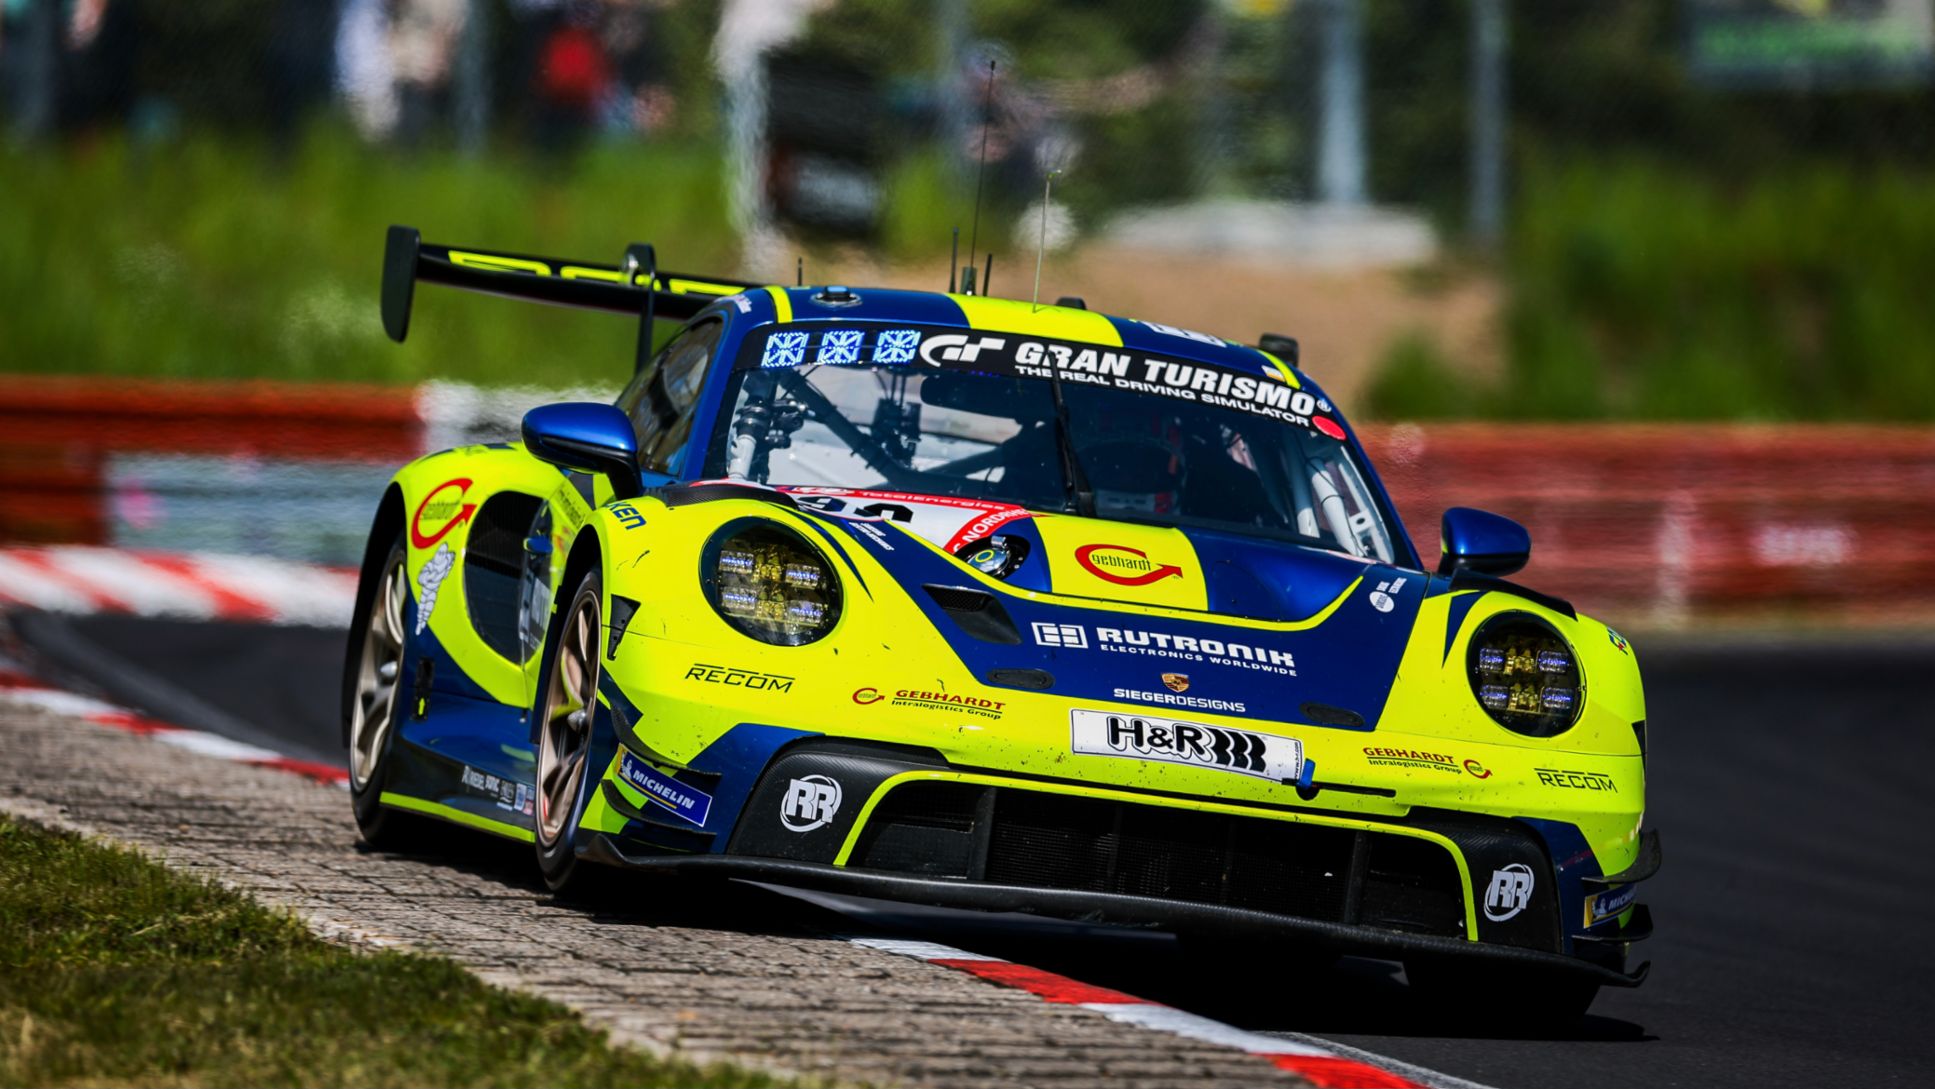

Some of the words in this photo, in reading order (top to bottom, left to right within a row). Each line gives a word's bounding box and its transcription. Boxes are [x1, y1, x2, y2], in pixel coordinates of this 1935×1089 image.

[1014, 342, 1130, 376] GRAN
[1014, 365, 1053, 377] THE
[1060, 371, 1110, 386] REAL
[1115, 378, 1196, 399] DRIVING
[1201, 393, 1309, 427] SIMULATOR
[1096, 626, 1295, 667] RUTRONIK
[1100, 644, 1203, 661] ELECTRONICS
[1209, 657, 1297, 677] WORLDWIDE
[684, 667, 793, 693] RECOM
[891, 700, 963, 713] Intralogistics
[967, 709, 1001, 720] Group
[895, 690, 1006, 710] GEBHARDT
[1113, 688, 1246, 712] SIEGERDESIGNS
[1107, 716, 1212, 762] H&R
[1363, 747, 1455, 764] GEBHARDT
[1369, 759, 1432, 769] Intralogistics
[1433, 764, 1462, 774] Group
[1538, 772, 1618, 794] RECOM
[633, 769, 696, 810] MICHELIN
[785, 779, 837, 824] RR
[1488, 869, 1530, 910] RR
